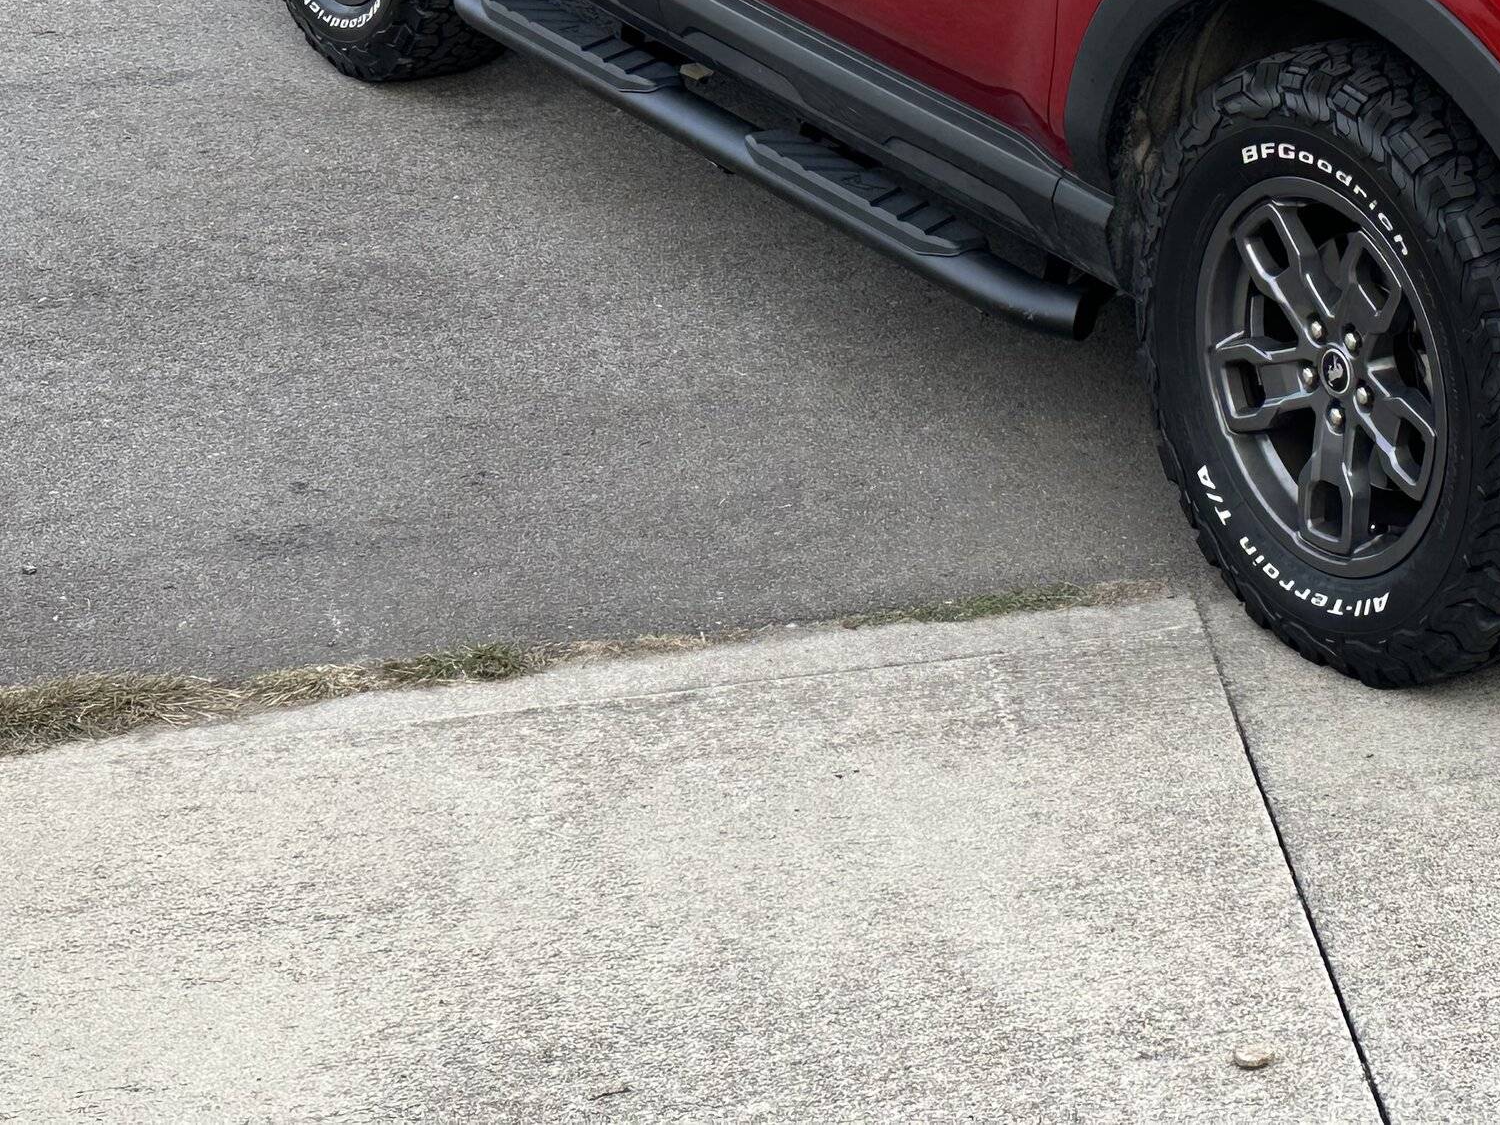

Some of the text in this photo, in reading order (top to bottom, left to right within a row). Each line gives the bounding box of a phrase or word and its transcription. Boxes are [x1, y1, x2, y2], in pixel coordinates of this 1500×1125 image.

[1241, 142, 1409, 256] BFGoodrich
[1197, 464, 1390, 617] All-Terrain T/A
